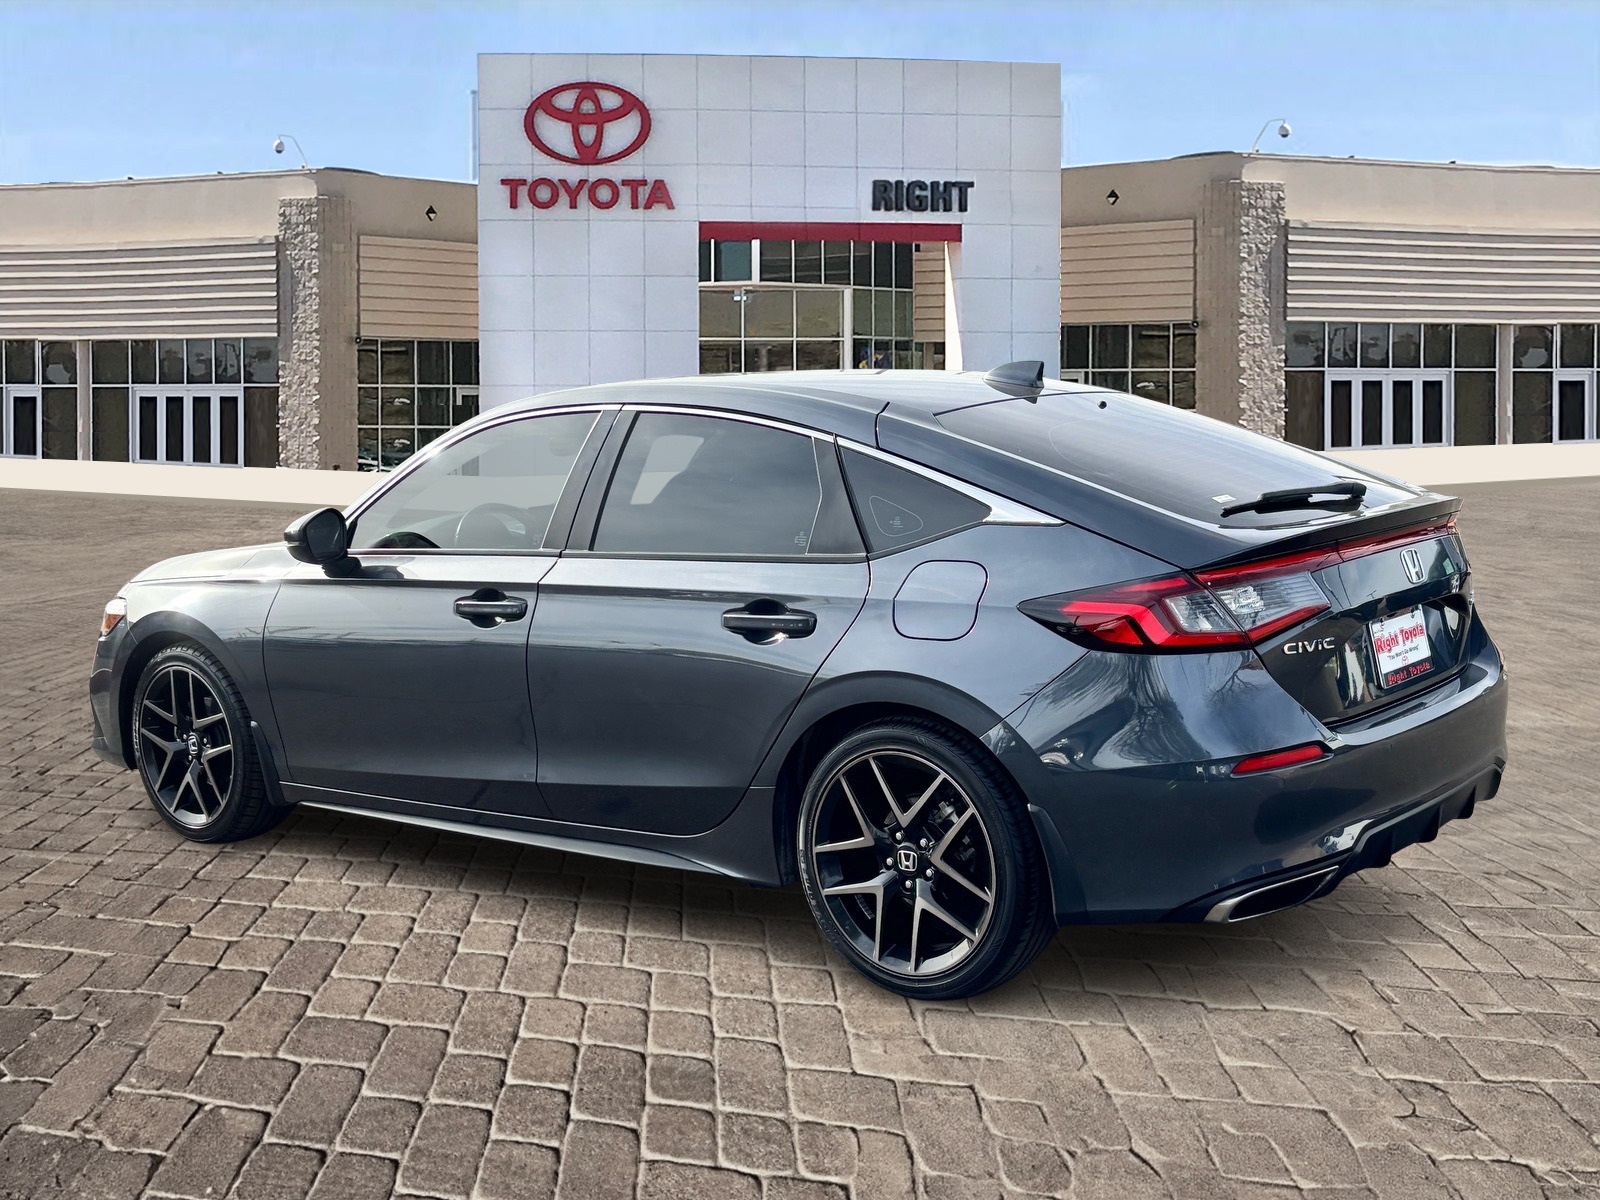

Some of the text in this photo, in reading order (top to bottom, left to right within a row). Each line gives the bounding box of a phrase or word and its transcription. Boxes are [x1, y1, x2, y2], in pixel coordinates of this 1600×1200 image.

[500, 178, 675, 209] TOYOTA
[872, 179, 975, 213] RIGHT
[1374, 623, 1425, 654] Right Toyota
[1388, 662, 1431, 685] Right Toyota
